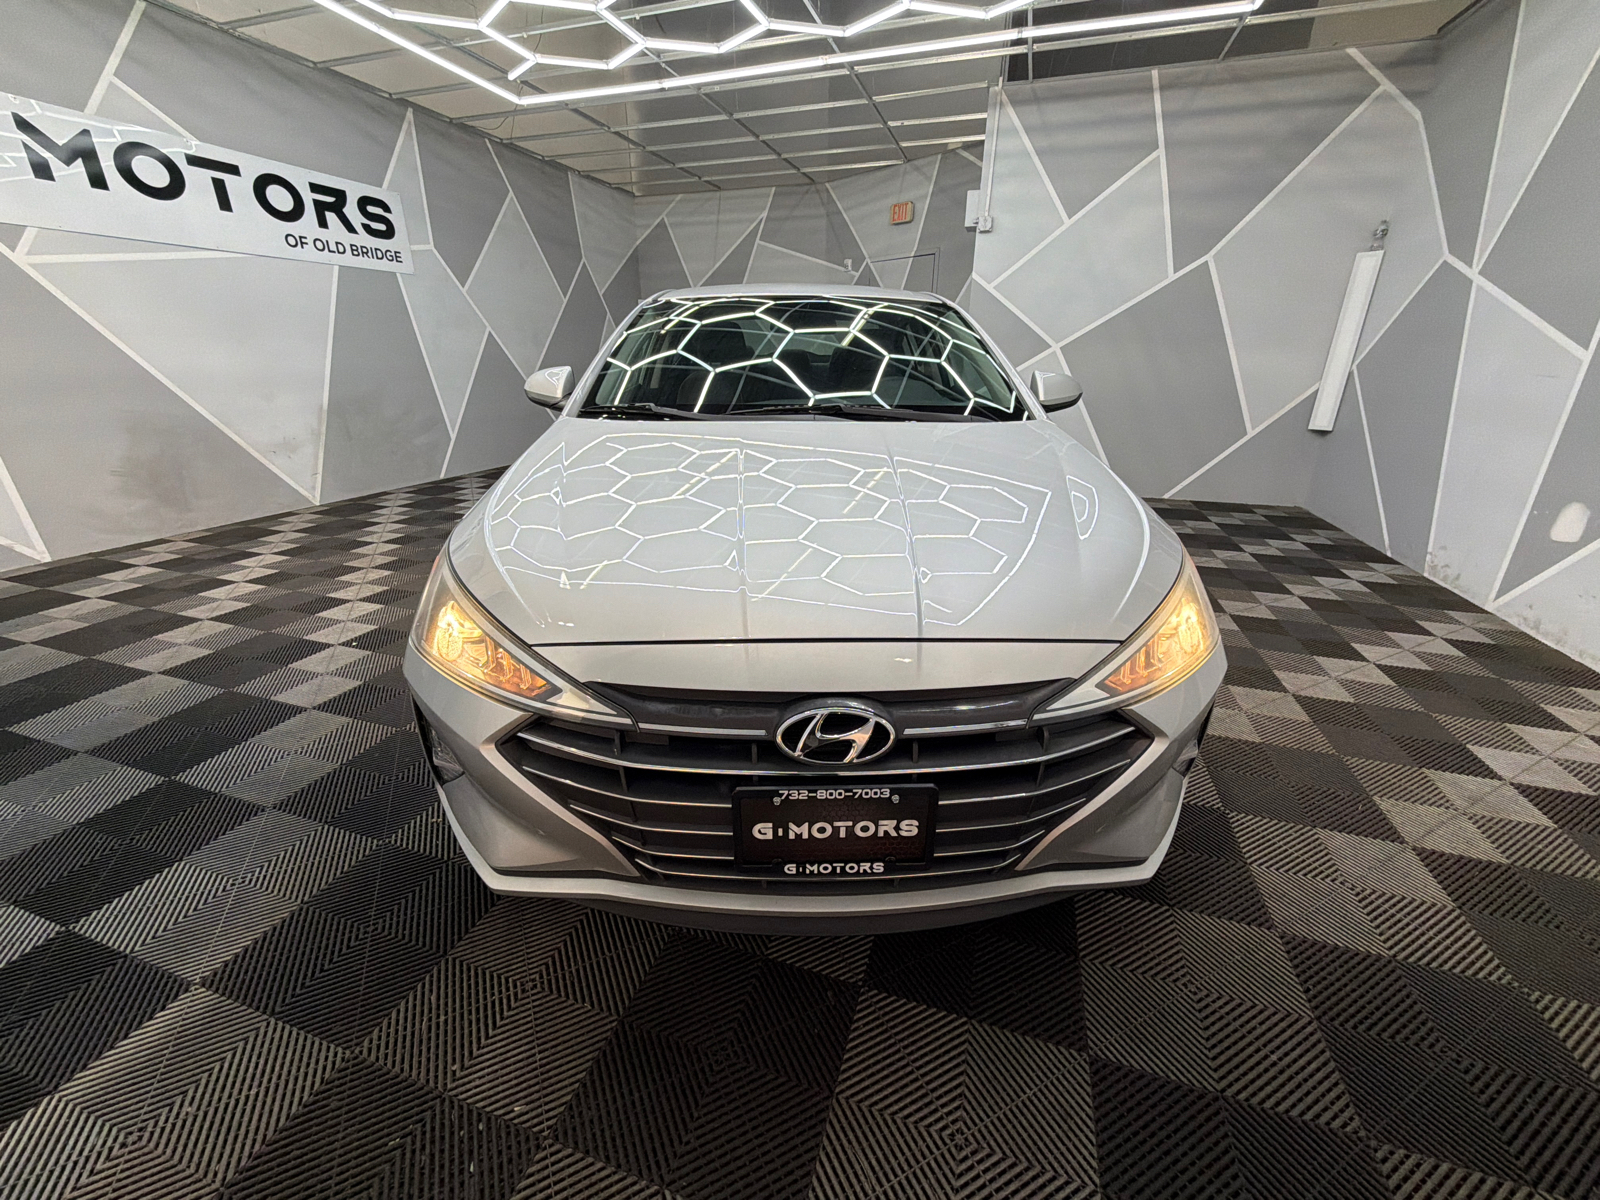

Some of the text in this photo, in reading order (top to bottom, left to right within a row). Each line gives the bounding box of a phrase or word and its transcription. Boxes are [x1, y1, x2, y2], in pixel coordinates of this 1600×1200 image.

[11, 111, 396, 240] MOTORS
[284, 233, 403, 263] OF OLD BRIDGE
[778, 788, 890, 800] 732-800-7003
